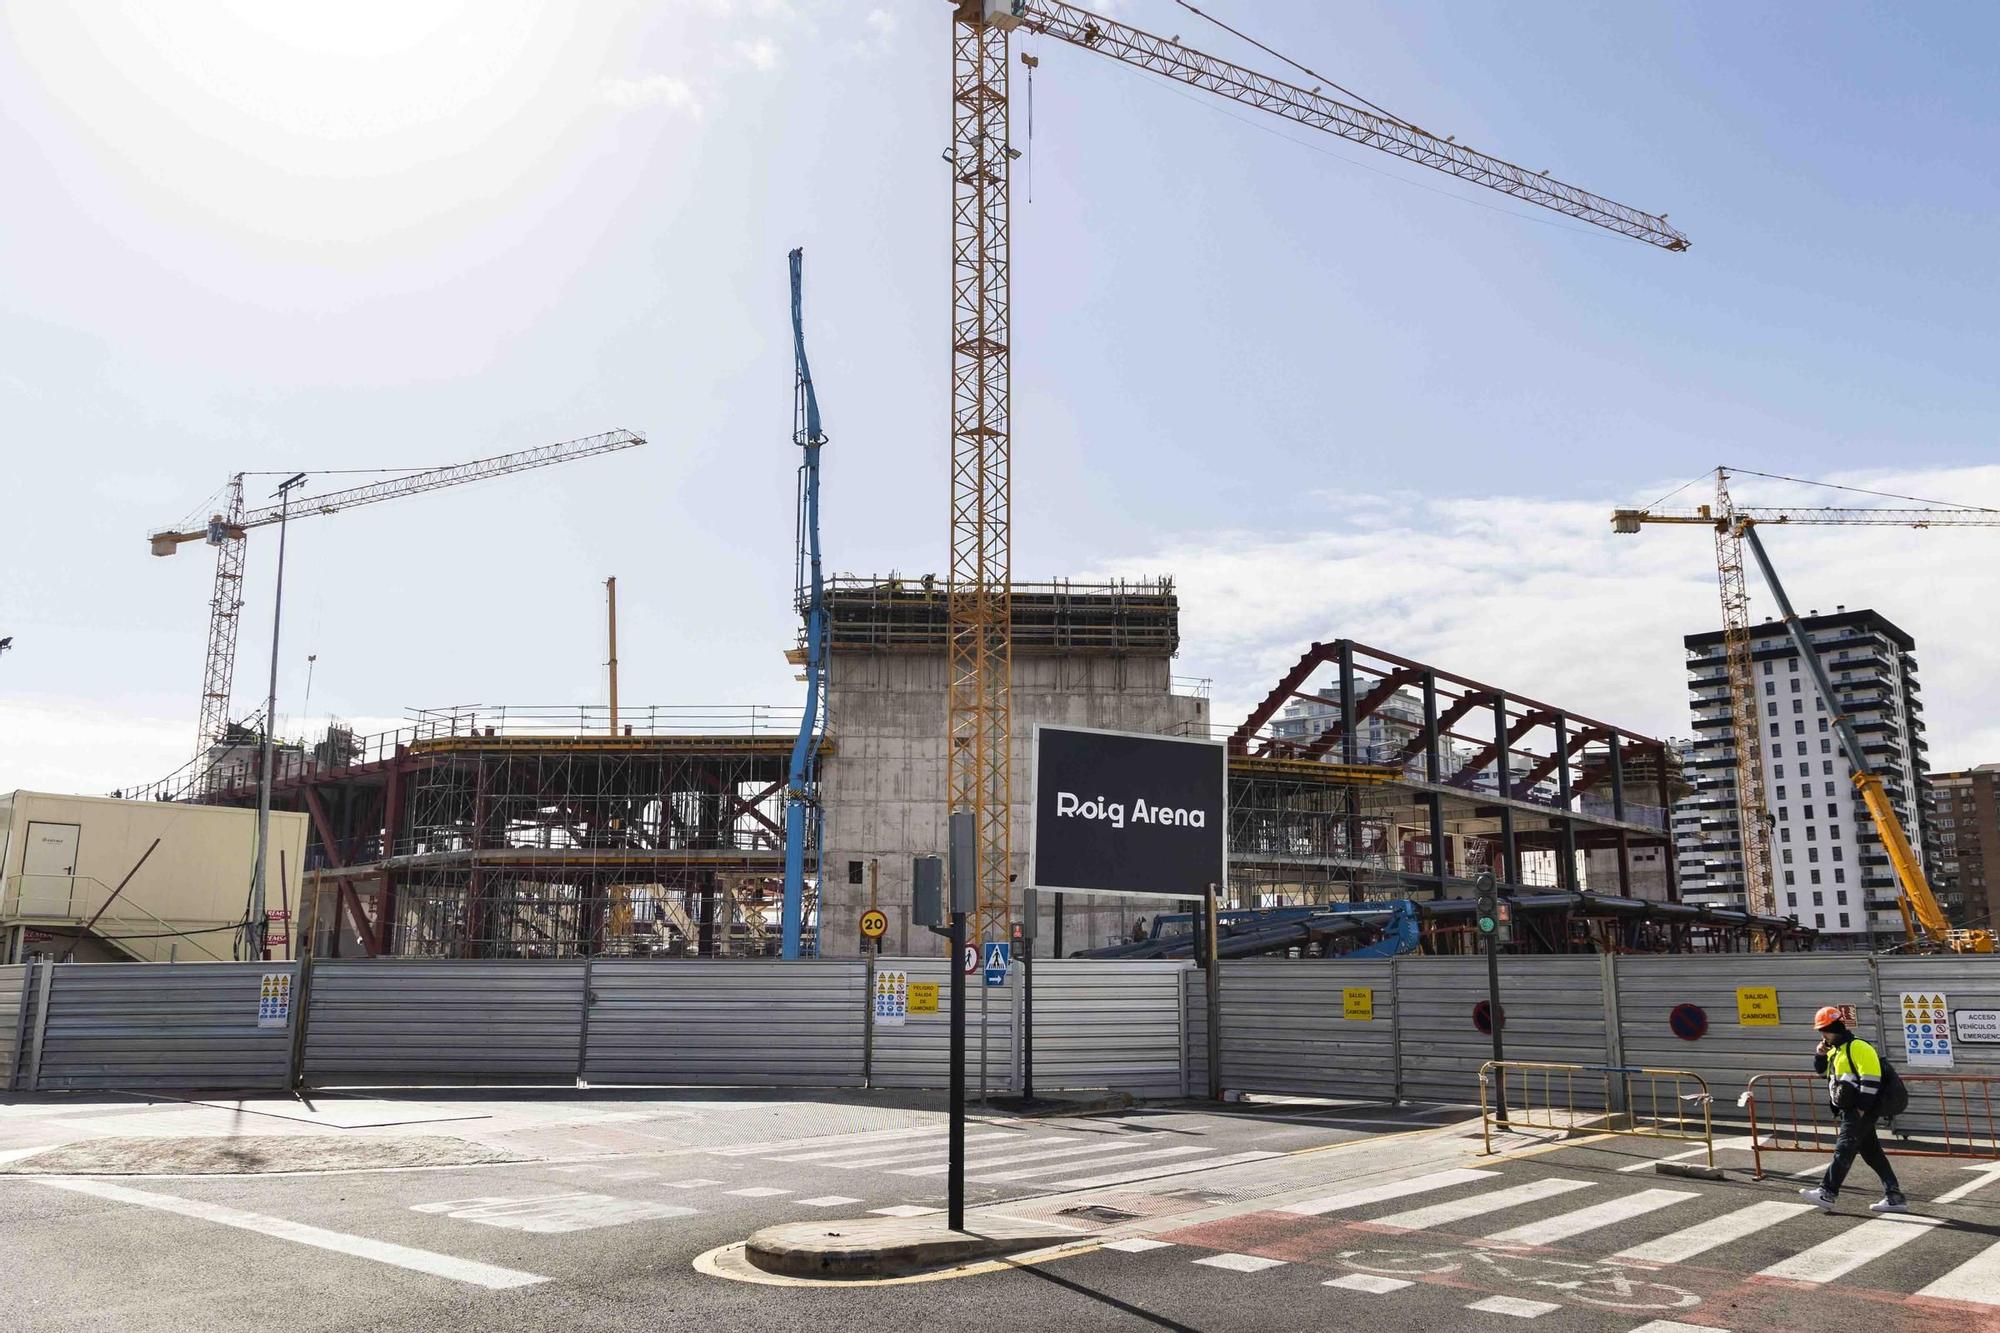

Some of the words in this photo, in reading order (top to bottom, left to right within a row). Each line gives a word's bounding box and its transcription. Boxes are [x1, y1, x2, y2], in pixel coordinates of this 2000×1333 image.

[1057, 791, 1124, 828] Roig
[1131, 798, 1205, 828] Arena
[864, 918, 883, 930] 20
[1959, 1022, 1997, 1030] VEHÍCULOS
